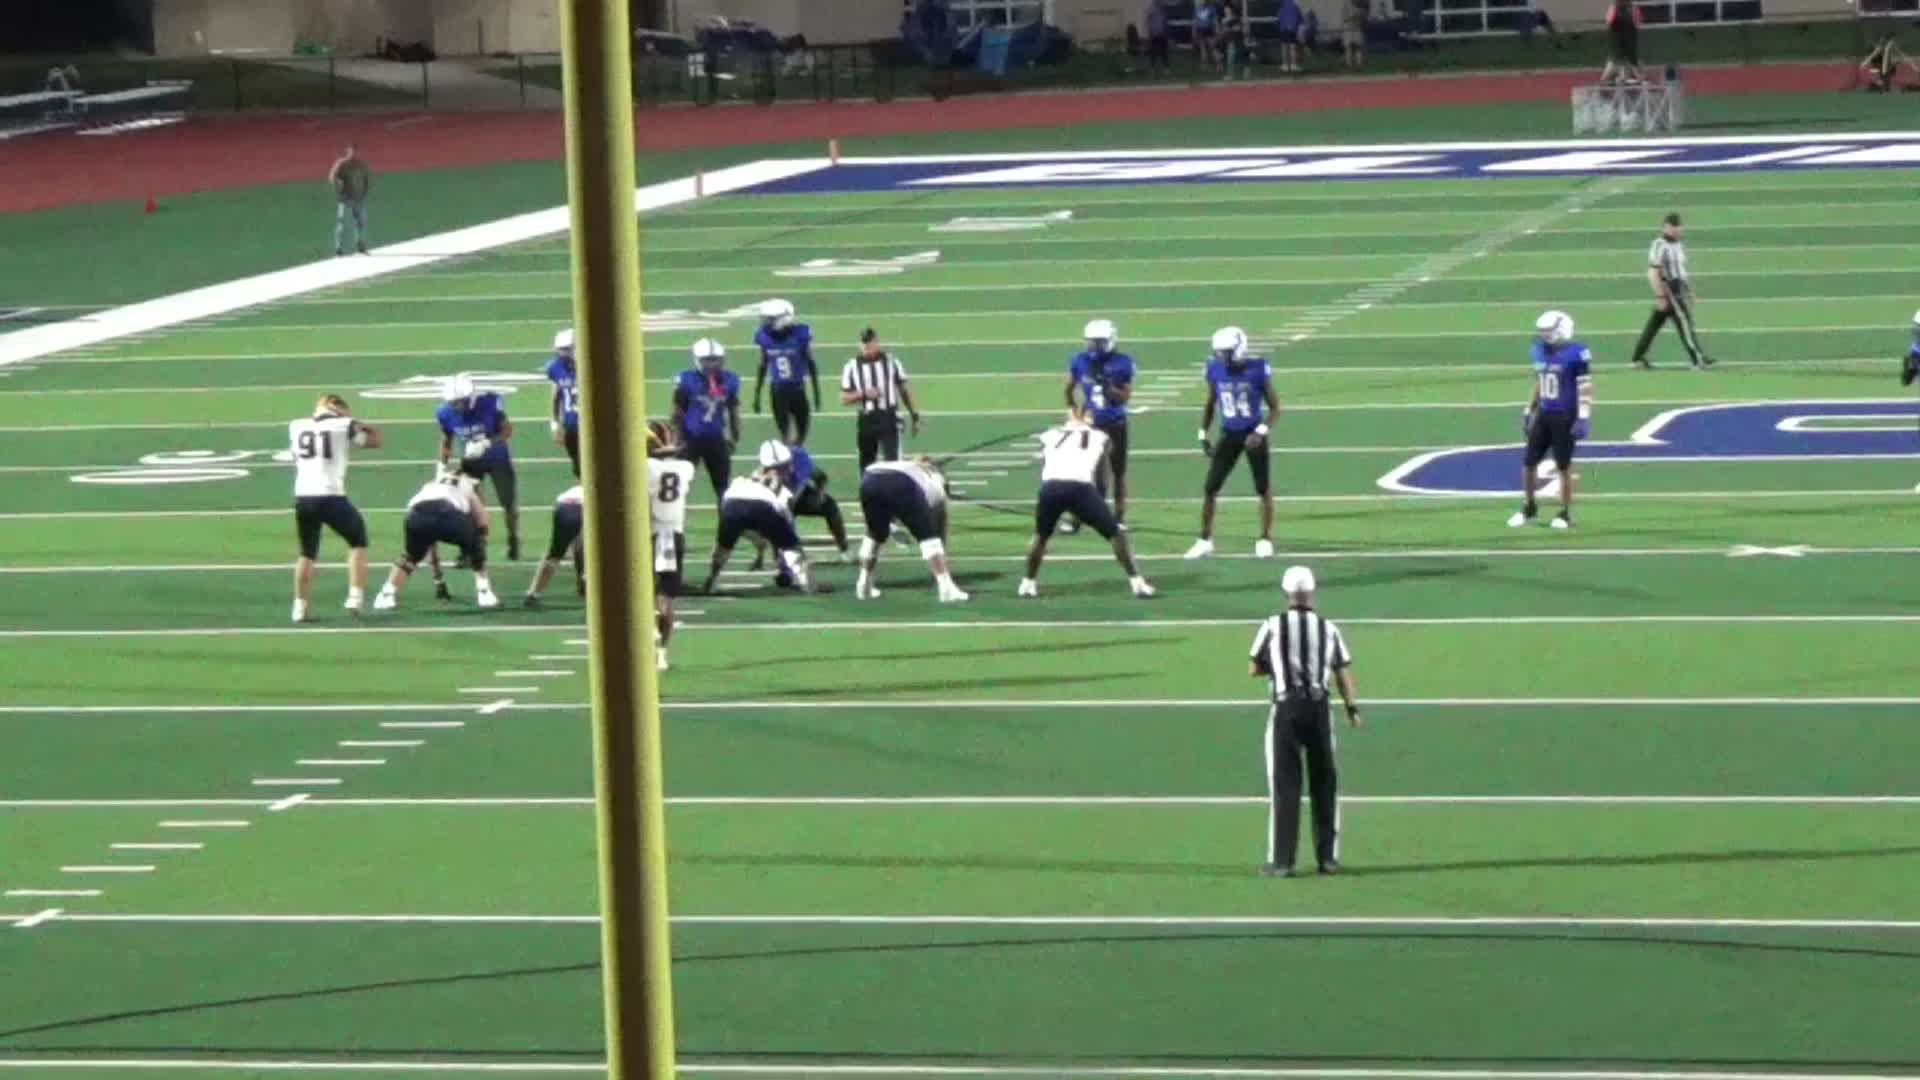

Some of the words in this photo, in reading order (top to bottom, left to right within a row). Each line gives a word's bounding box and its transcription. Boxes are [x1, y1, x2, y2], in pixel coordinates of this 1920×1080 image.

[776, 356, 790, 379] 9
[1539, 372, 1559, 399] 10
[298, 429, 334, 460] 91
[1055, 429, 1089, 449] 71
[658, 471, 680, 503] 8
